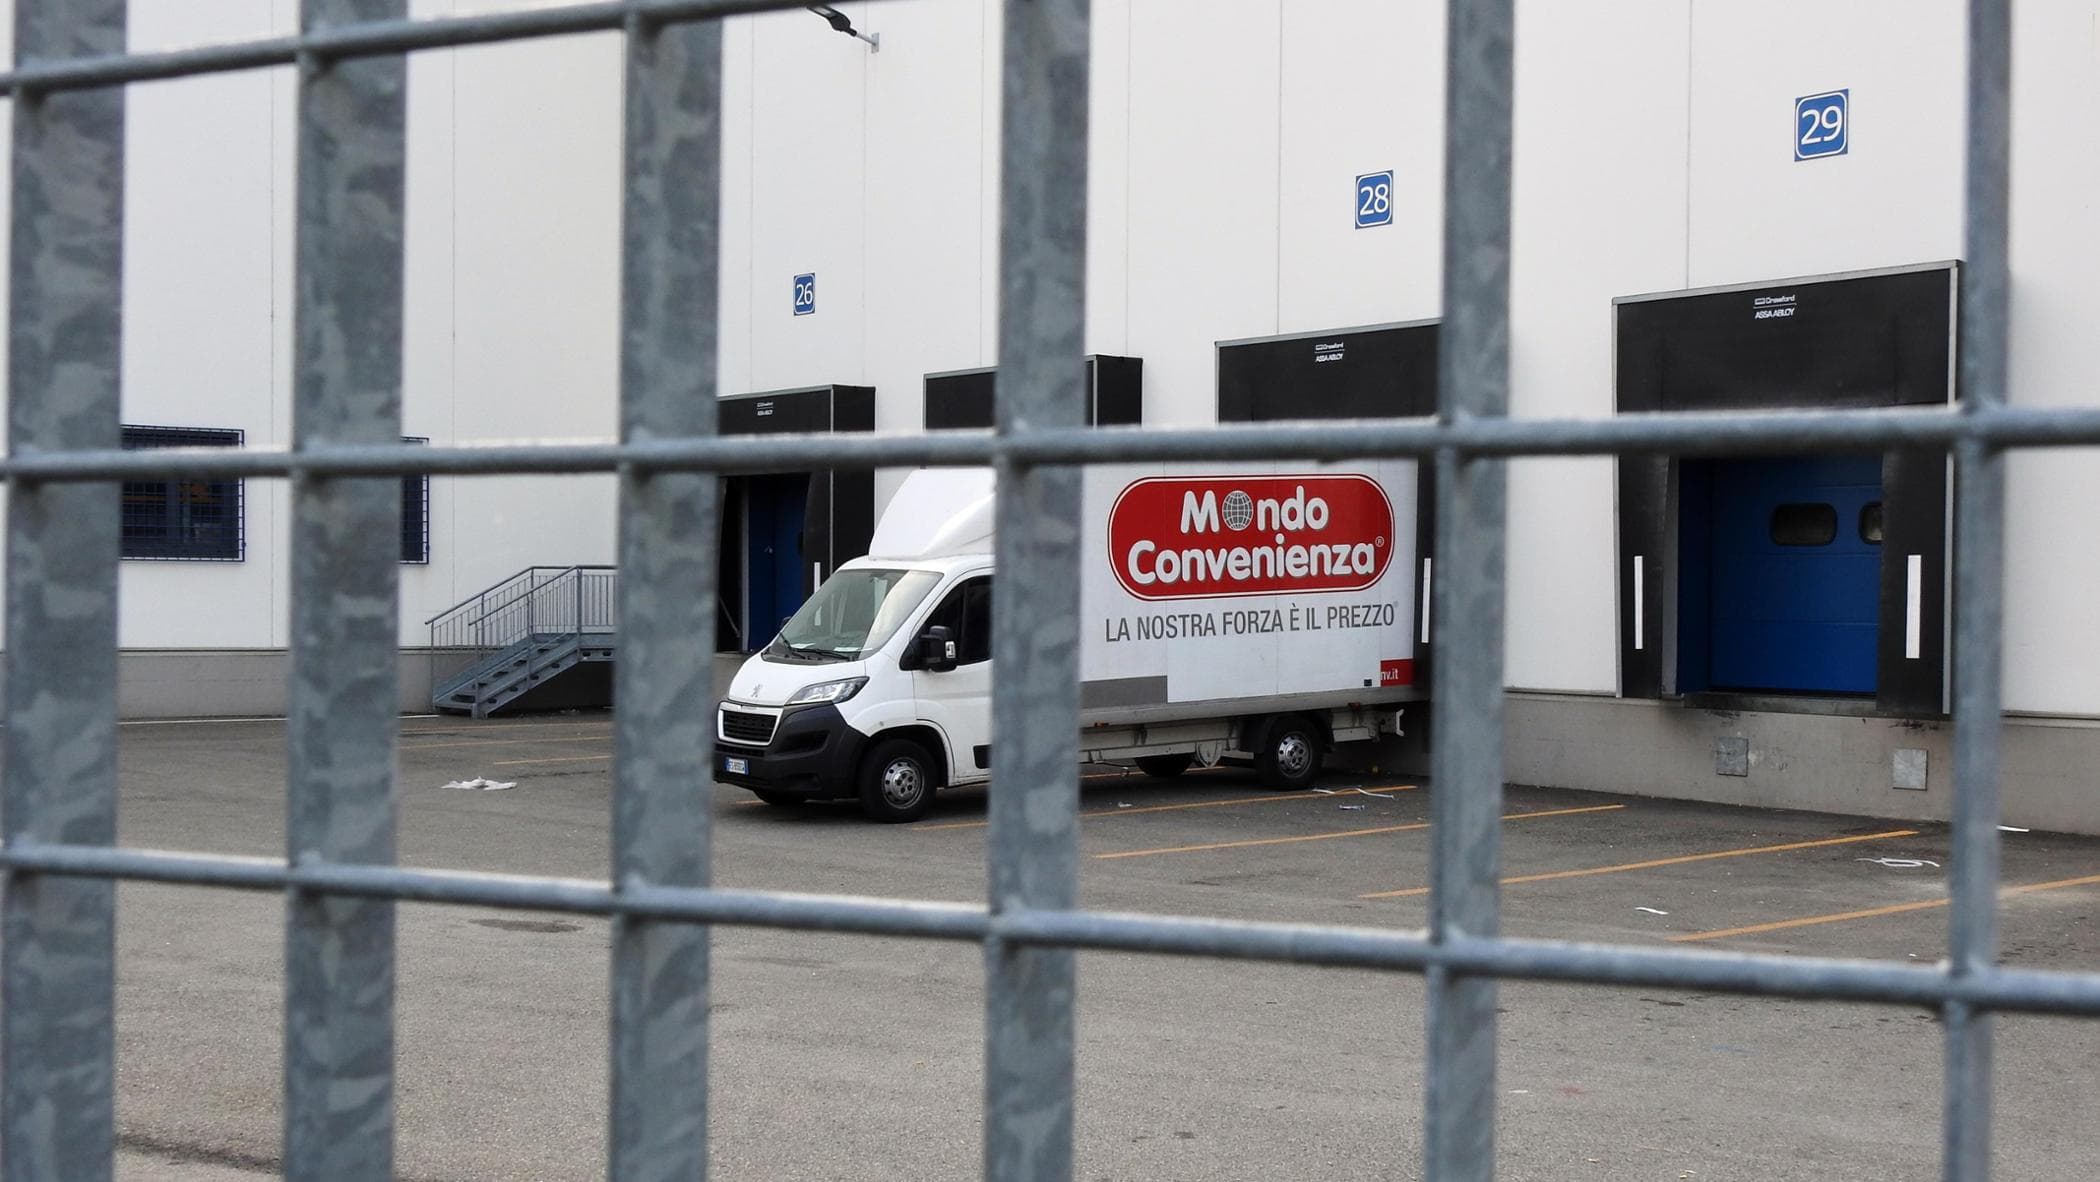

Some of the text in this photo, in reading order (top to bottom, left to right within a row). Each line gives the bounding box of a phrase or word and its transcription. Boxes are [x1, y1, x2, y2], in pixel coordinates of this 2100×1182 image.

[1801, 105, 1843, 145] 29
[1359, 183, 1389, 216] 28
[795, 282, 813, 306] 26
[1105, 603, 1395, 642] LA NOSTRA FORZA È IL PREZZO
